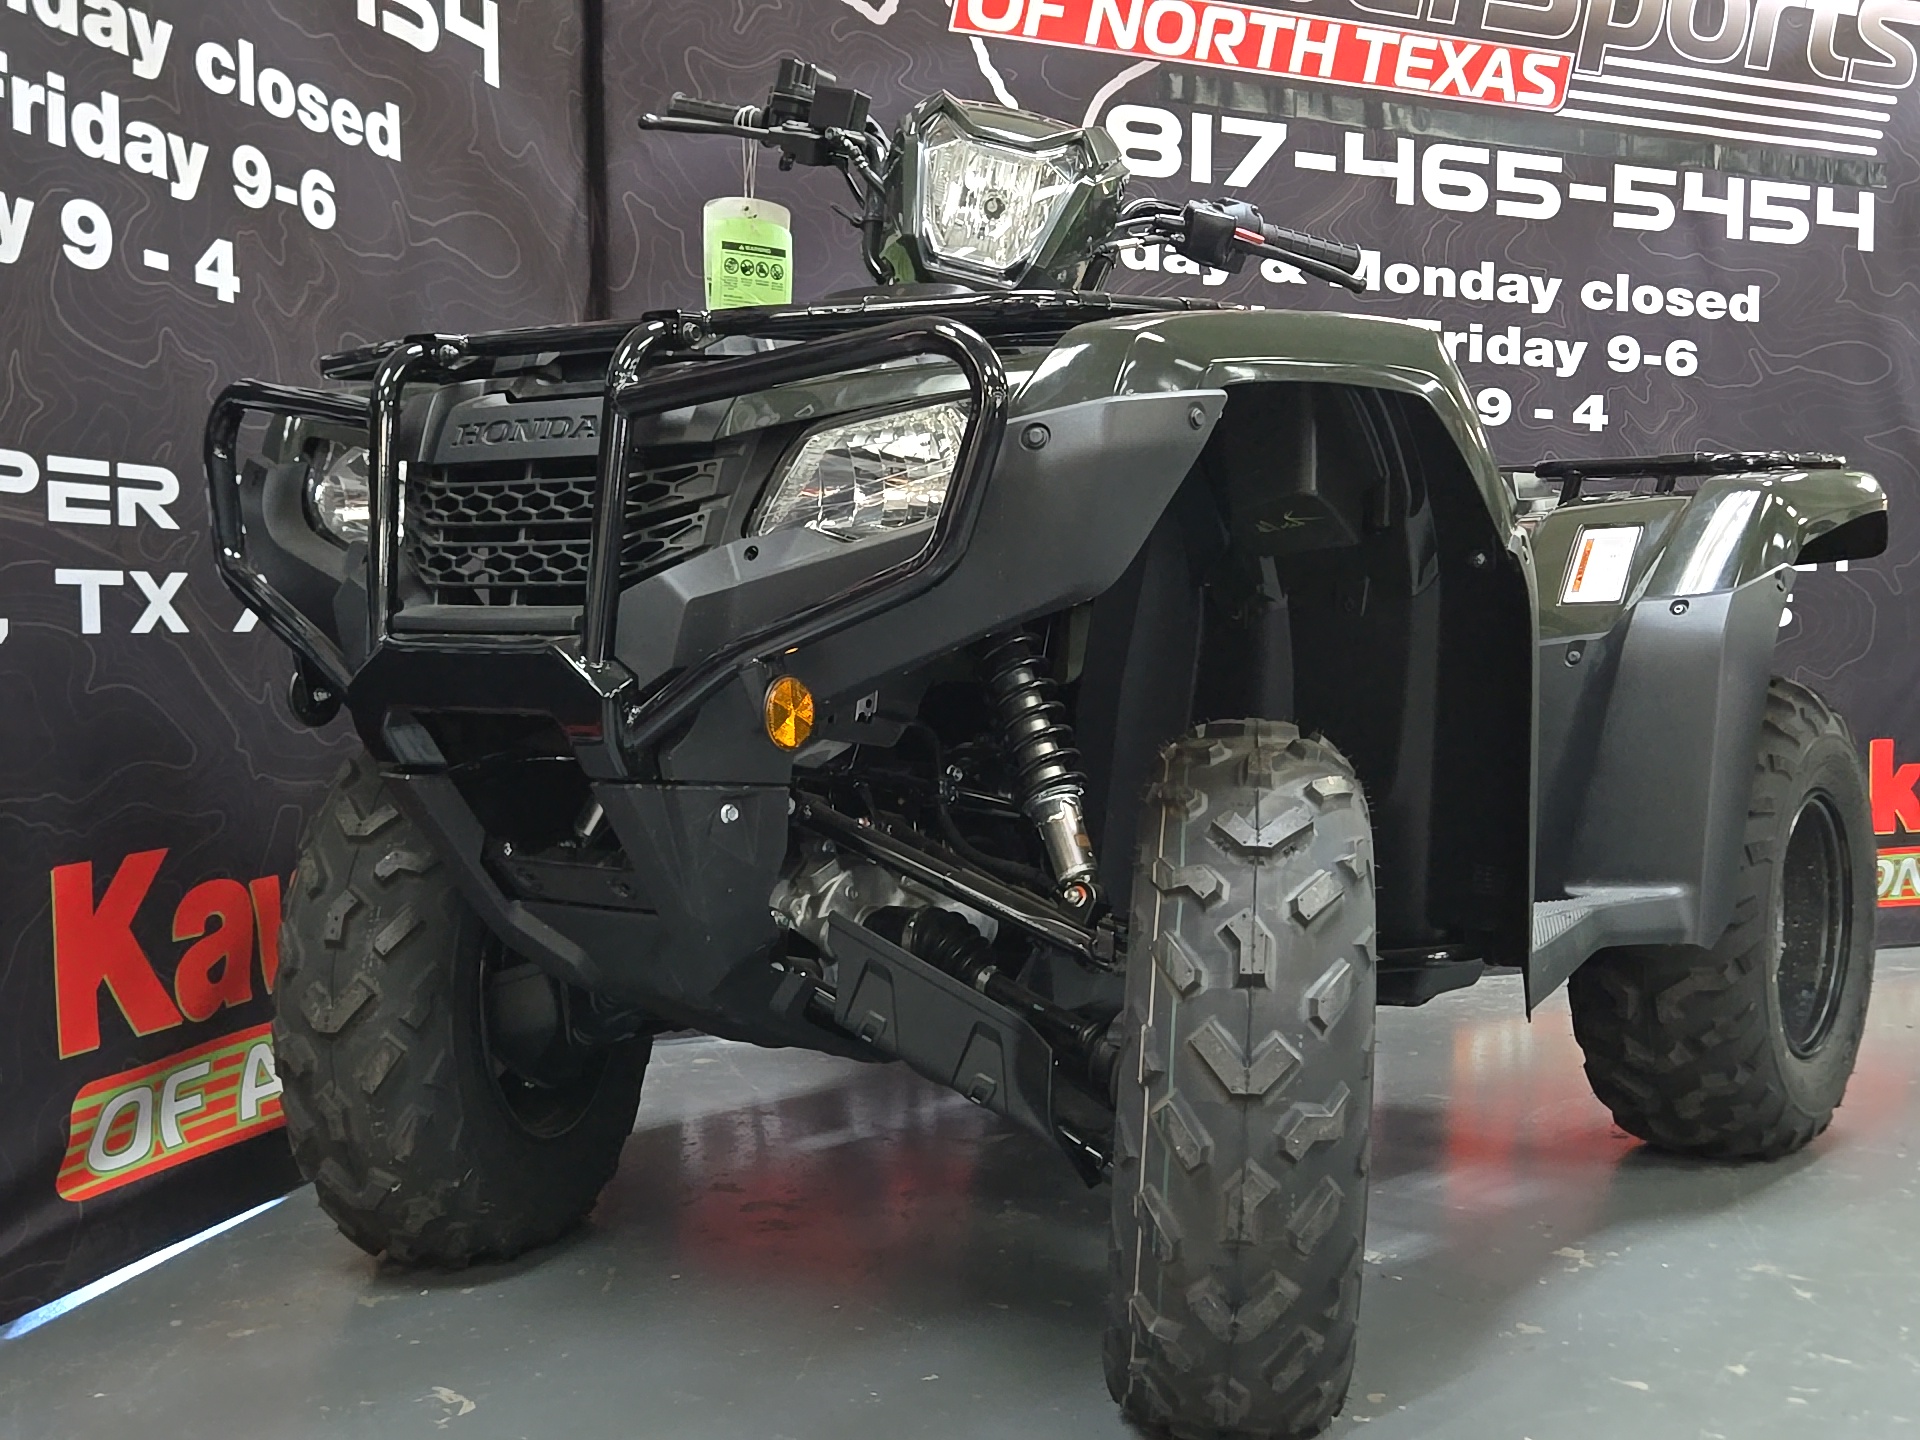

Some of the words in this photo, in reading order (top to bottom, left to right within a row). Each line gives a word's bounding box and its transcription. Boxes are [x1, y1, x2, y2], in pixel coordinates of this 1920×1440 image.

[1084, 0, 1341, 78] NORTH
[1355, 27, 1560, 107] TEXAS
[195, 38, 402, 162] closed
[232, 145, 337, 230] 9-6
[1106, 104, 1875, 253] 817-465-5454
[61, 199, 113, 270] 9
[143, 249, 170, 271] -
[195, 239, 241, 303] 4
[1580, 273, 1761, 323] closed
[1607, 335, 1698, 377] 9-6
[451, 414, 598, 448] HONDA
[1476, 388, 1512, 426] 9
[1534, 408, 1554, 420] -
[1572, 394, 1609, 432] 4
[55, 568, 190, 634] TX
[87, 1060, 211, 1172] OF
